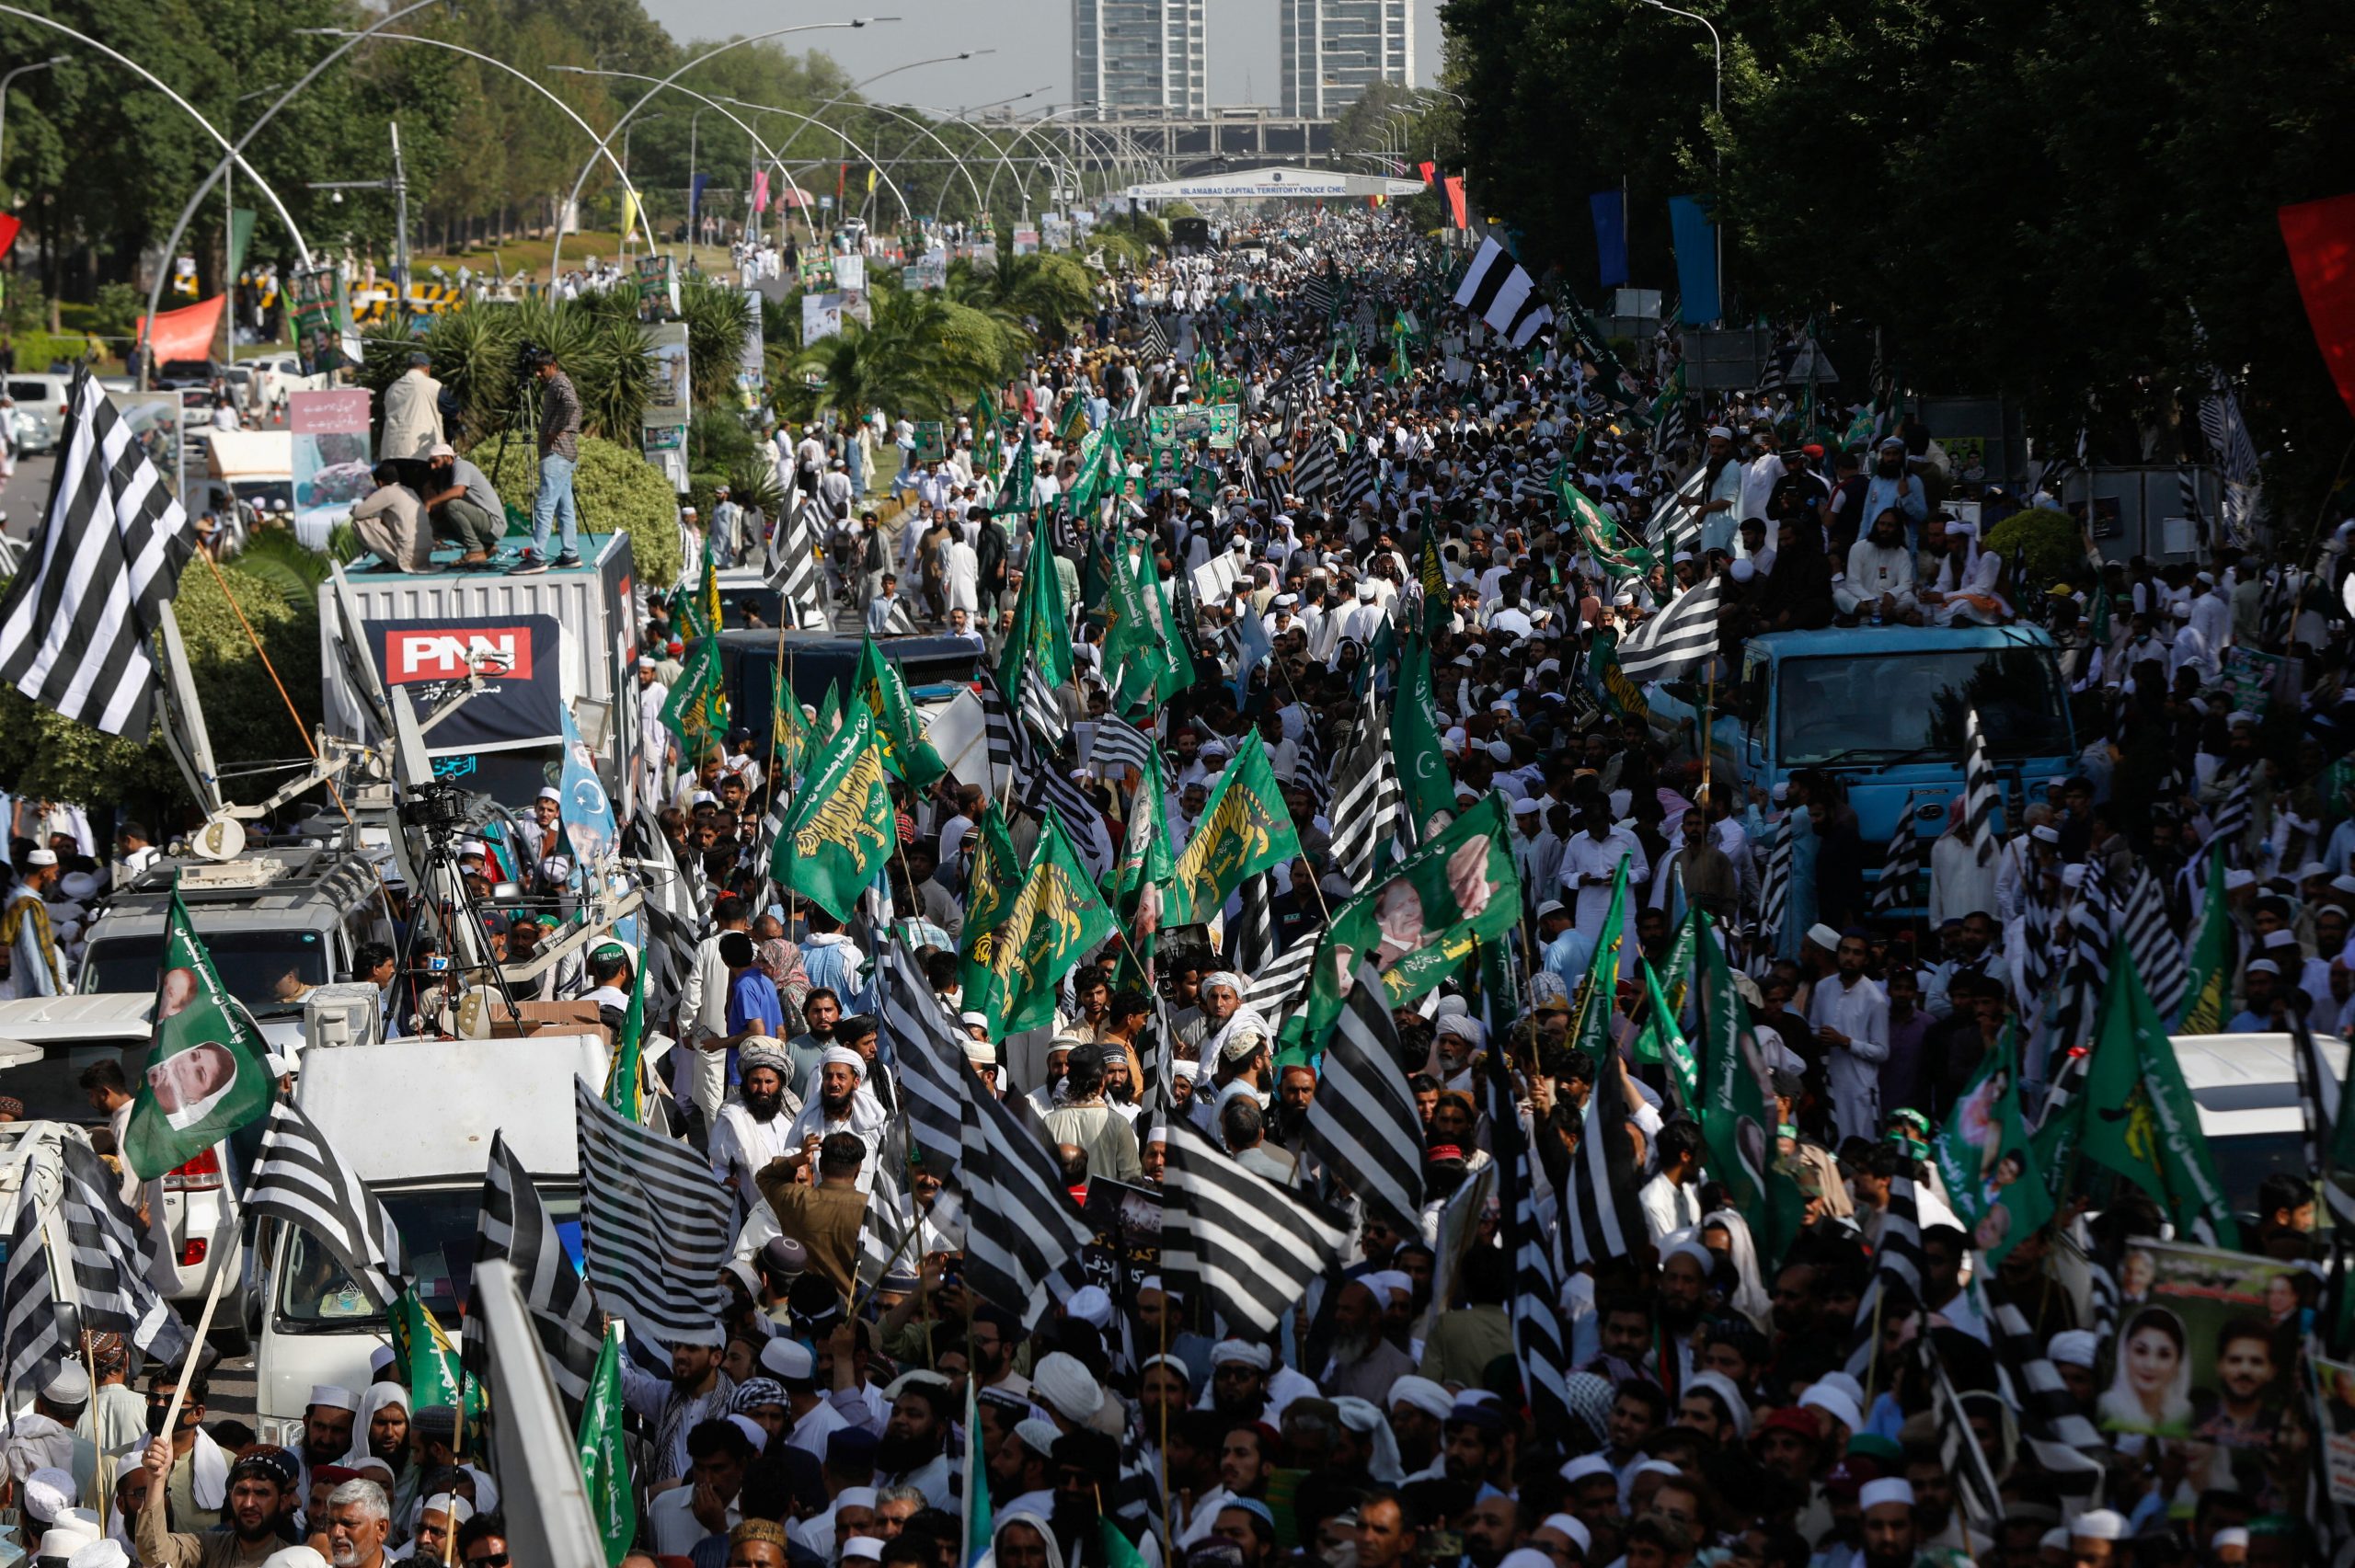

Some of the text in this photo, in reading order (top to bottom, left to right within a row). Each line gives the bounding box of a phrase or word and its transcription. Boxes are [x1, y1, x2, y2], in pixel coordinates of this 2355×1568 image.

[1258, 186, 1297, 194] TERRITORY
[1115, 559, 1129, 586] مسلم
[1120, 586, 1143, 627] پاکستان
[402, 635, 515, 673] PNN
[1161, 635, 1179, 673] پاکستا
[212, 994, 246, 1044] پاکستان
[601, 1435, 615, 1477] مسلم
[606, 1480, 622, 1539] پاکستان
